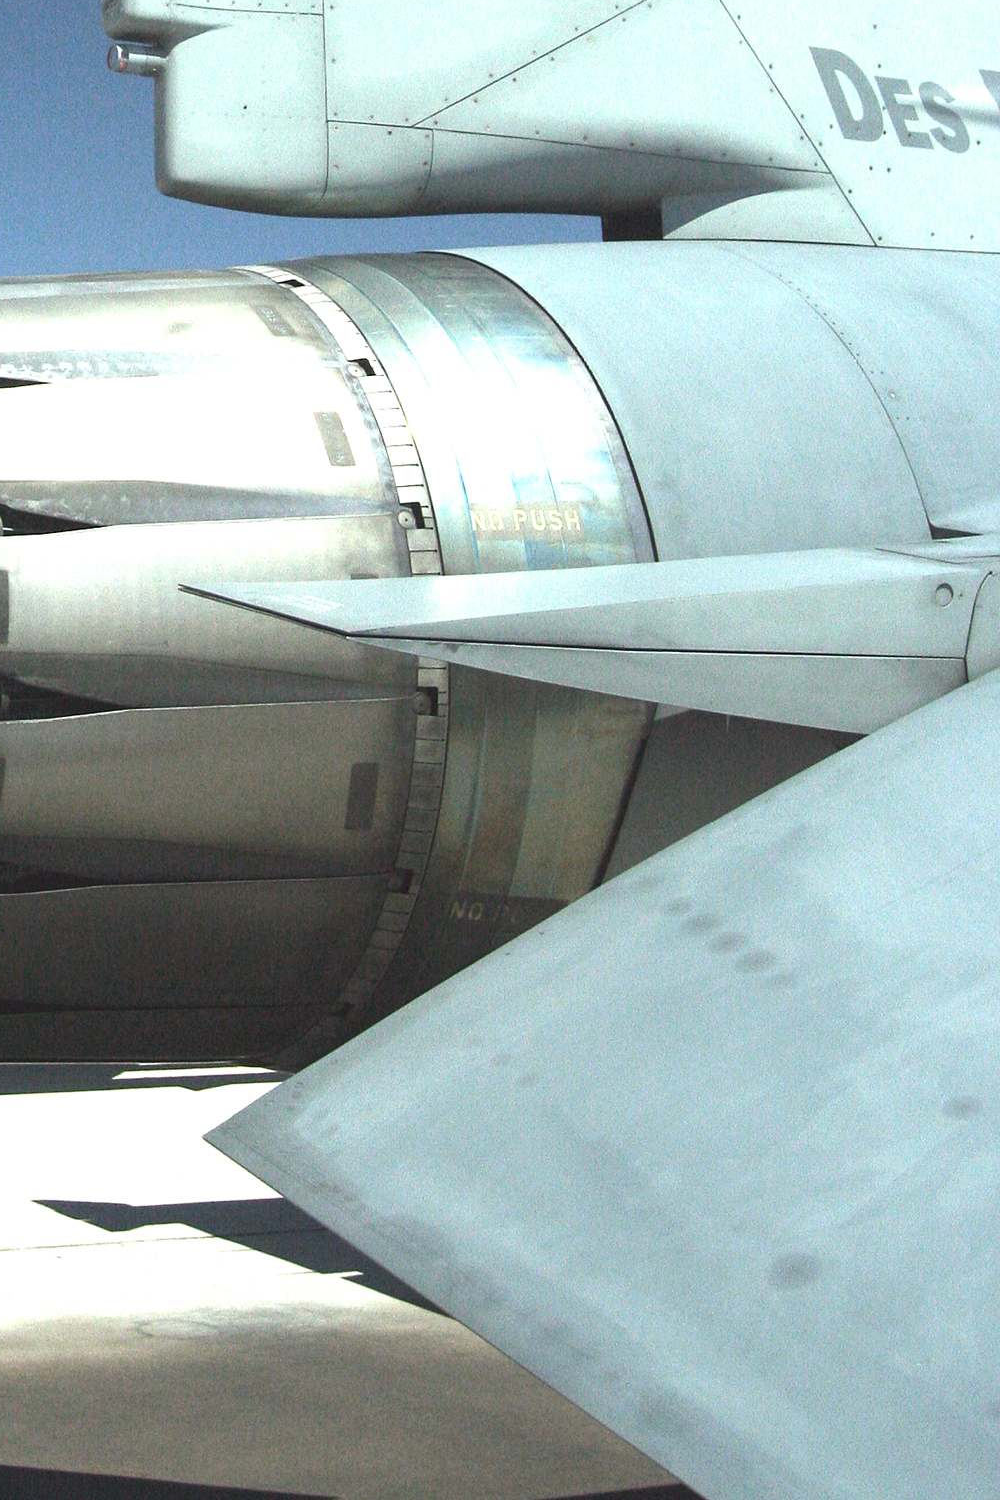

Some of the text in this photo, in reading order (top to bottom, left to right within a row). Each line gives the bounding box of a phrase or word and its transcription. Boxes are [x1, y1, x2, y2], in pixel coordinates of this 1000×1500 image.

[808, 45, 971, 154] DES
[469, 508, 581, 531] NO PUSH
